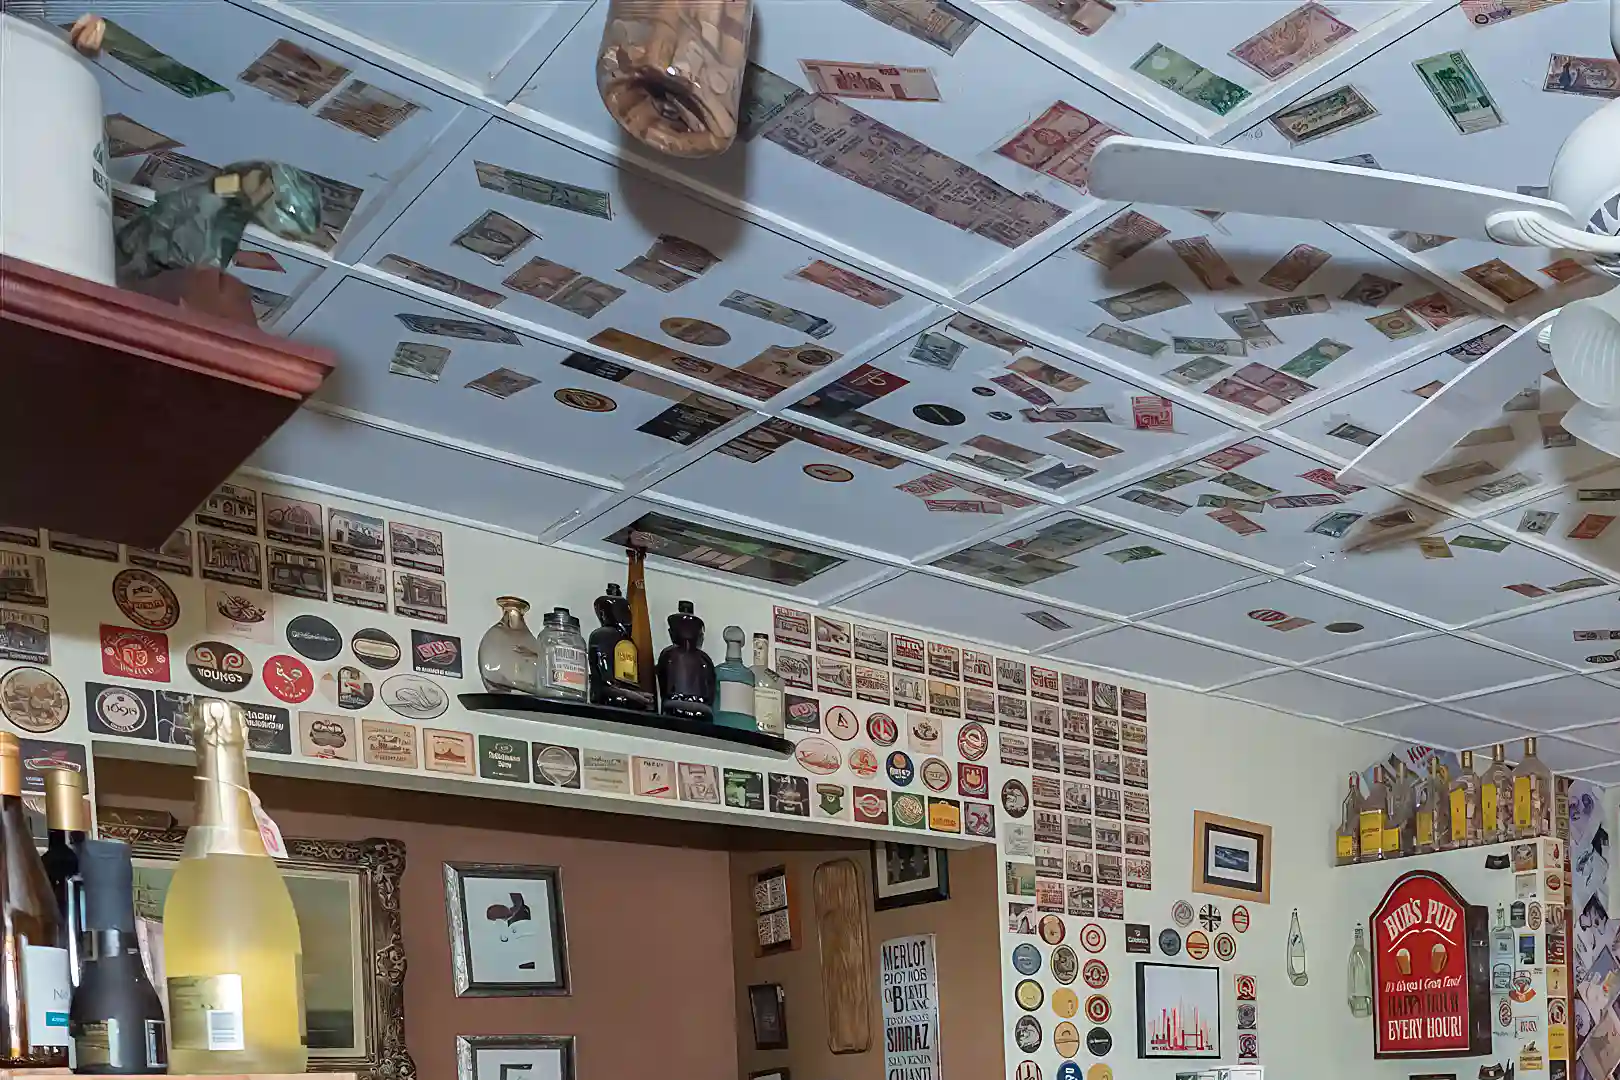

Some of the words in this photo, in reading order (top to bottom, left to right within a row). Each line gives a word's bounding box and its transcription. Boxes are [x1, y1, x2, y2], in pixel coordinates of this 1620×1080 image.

[1383, 898, 1423, 942] BUB'S
[1425, 898, 1458, 932] PUB
[882, 940, 927, 971] MERLOT
[887, 1023, 930, 1053] SHIRAZ
[1388, 1018, 1422, 1041] EVERY
[1427, 1015, 1462, 1039] HOUR!
